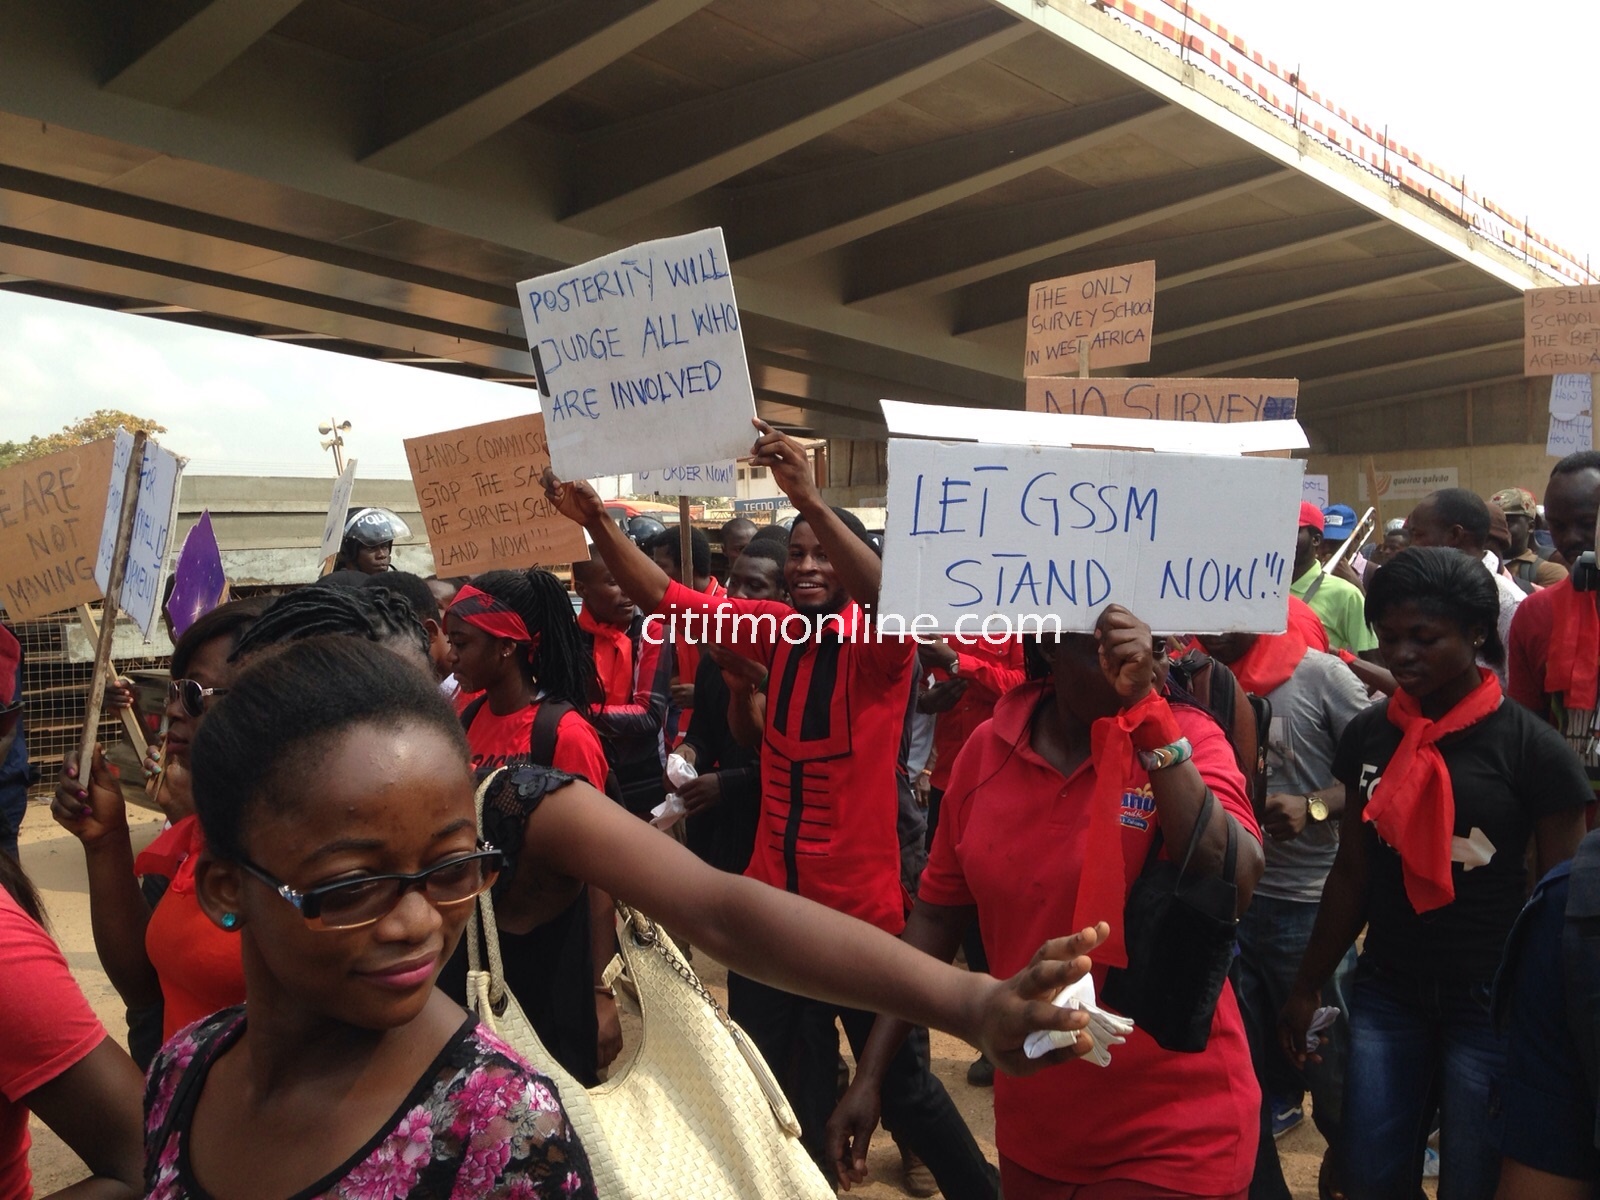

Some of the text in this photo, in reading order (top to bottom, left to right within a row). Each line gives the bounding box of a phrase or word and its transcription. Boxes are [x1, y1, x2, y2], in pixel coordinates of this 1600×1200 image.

[529, 247, 729, 324] POSTERITY WILL
[1035, 274, 1132, 310] THE ONLY
[1531, 291, 1546, 309] IS
[541, 302, 739, 375] JUDGE ALL WHO
[1031, 308, 1098, 335] SURVEY
[1530, 311, 1595, 330] SCHOOL
[1026, 328, 1146, 366] IN WEST AFRICA
[1531, 333, 1559, 348] THE
[1529, 350, 1600, 369] AGENDA
[552, 359, 722, 422] ARE INVOLVED
[1045, 385, 1108, 418] NO
[414, 440, 470, 474] LANDS
[23, 467, 81, 521] ARE
[421, 481, 461, 509] STOP
[471, 472, 504, 497] THE
[910, 465, 1158, 541] LET GSSM
[431, 497, 559, 536] OF SURVEY SCHO
[26, 517, 80, 561] NOT
[441, 541, 479, 567] LAND
[945, 553, 1112, 608] STAND
